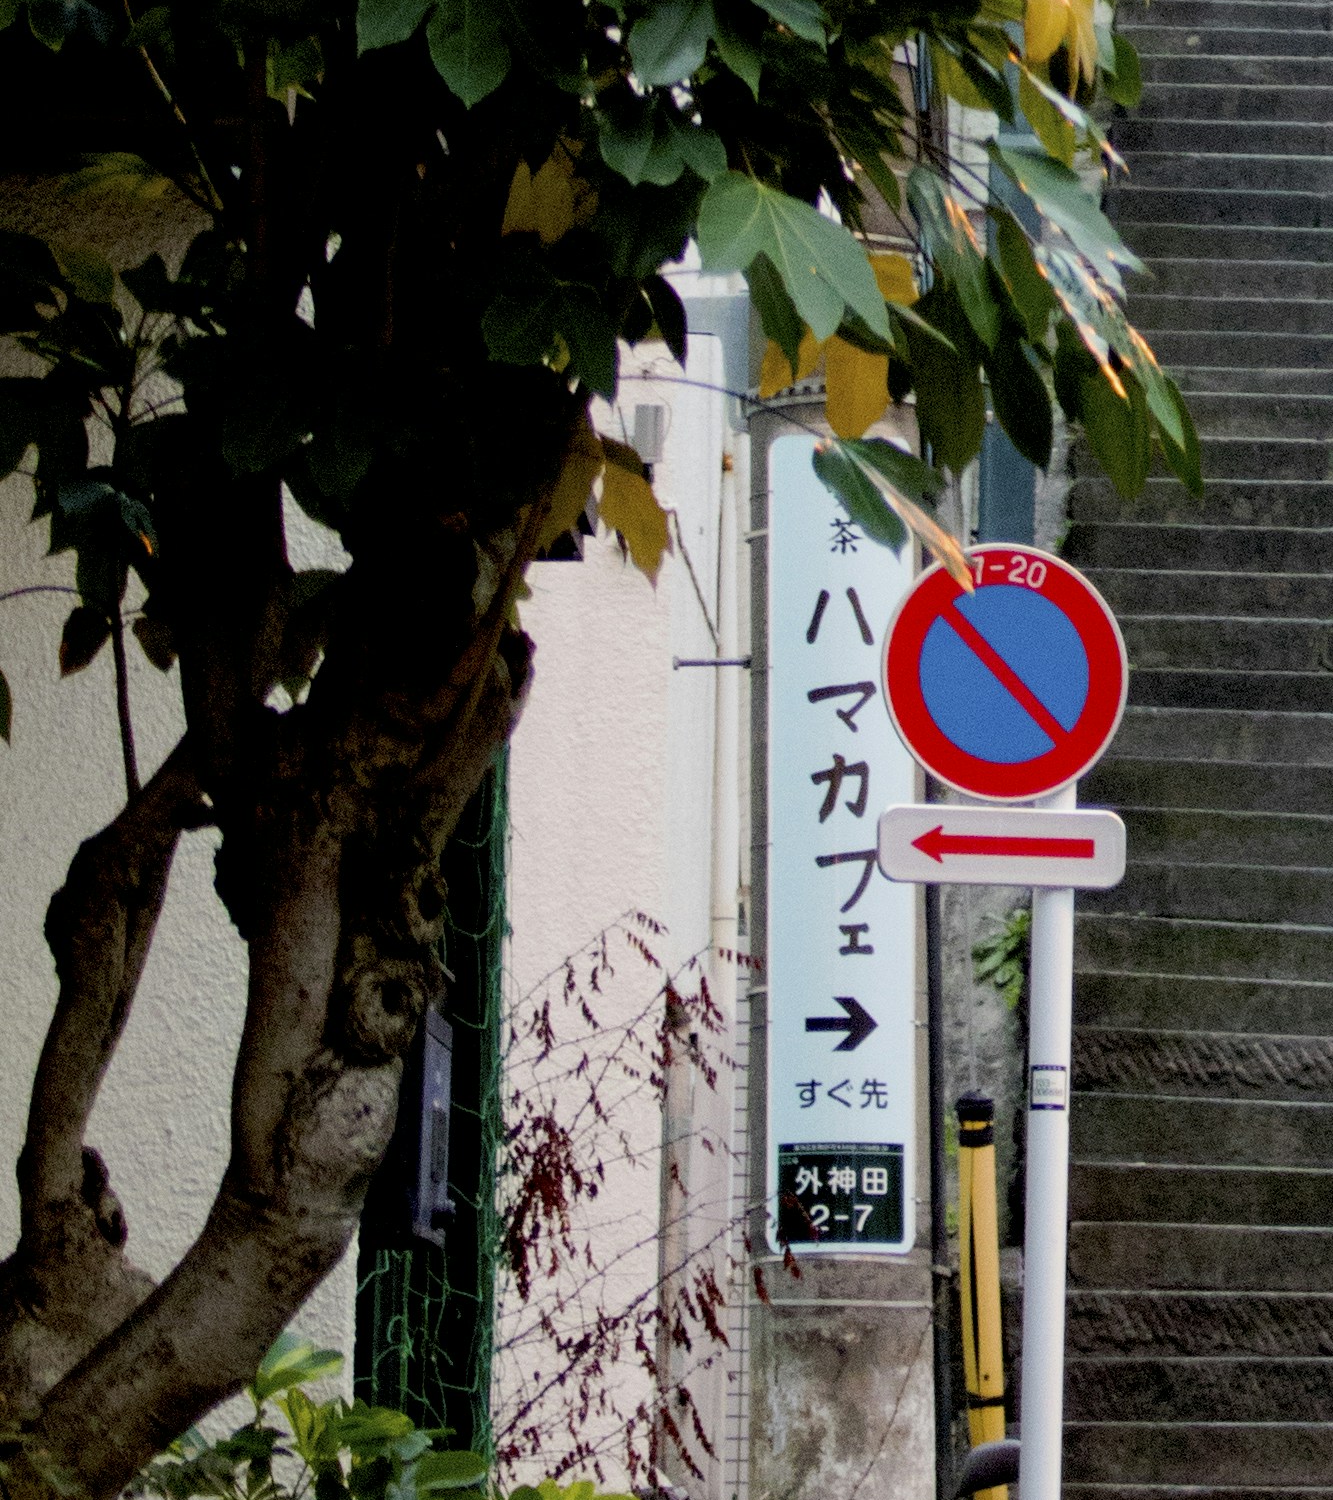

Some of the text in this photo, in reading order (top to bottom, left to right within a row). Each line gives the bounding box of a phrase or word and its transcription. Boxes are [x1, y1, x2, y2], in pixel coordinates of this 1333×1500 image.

[806, 587, 880, 956] ハマカフェ
[796, 1079, 889, 1109] すぐ先
[796, 1165, 889, 1195] 外神田
[810, 1204, 874, 1232] 2-7
